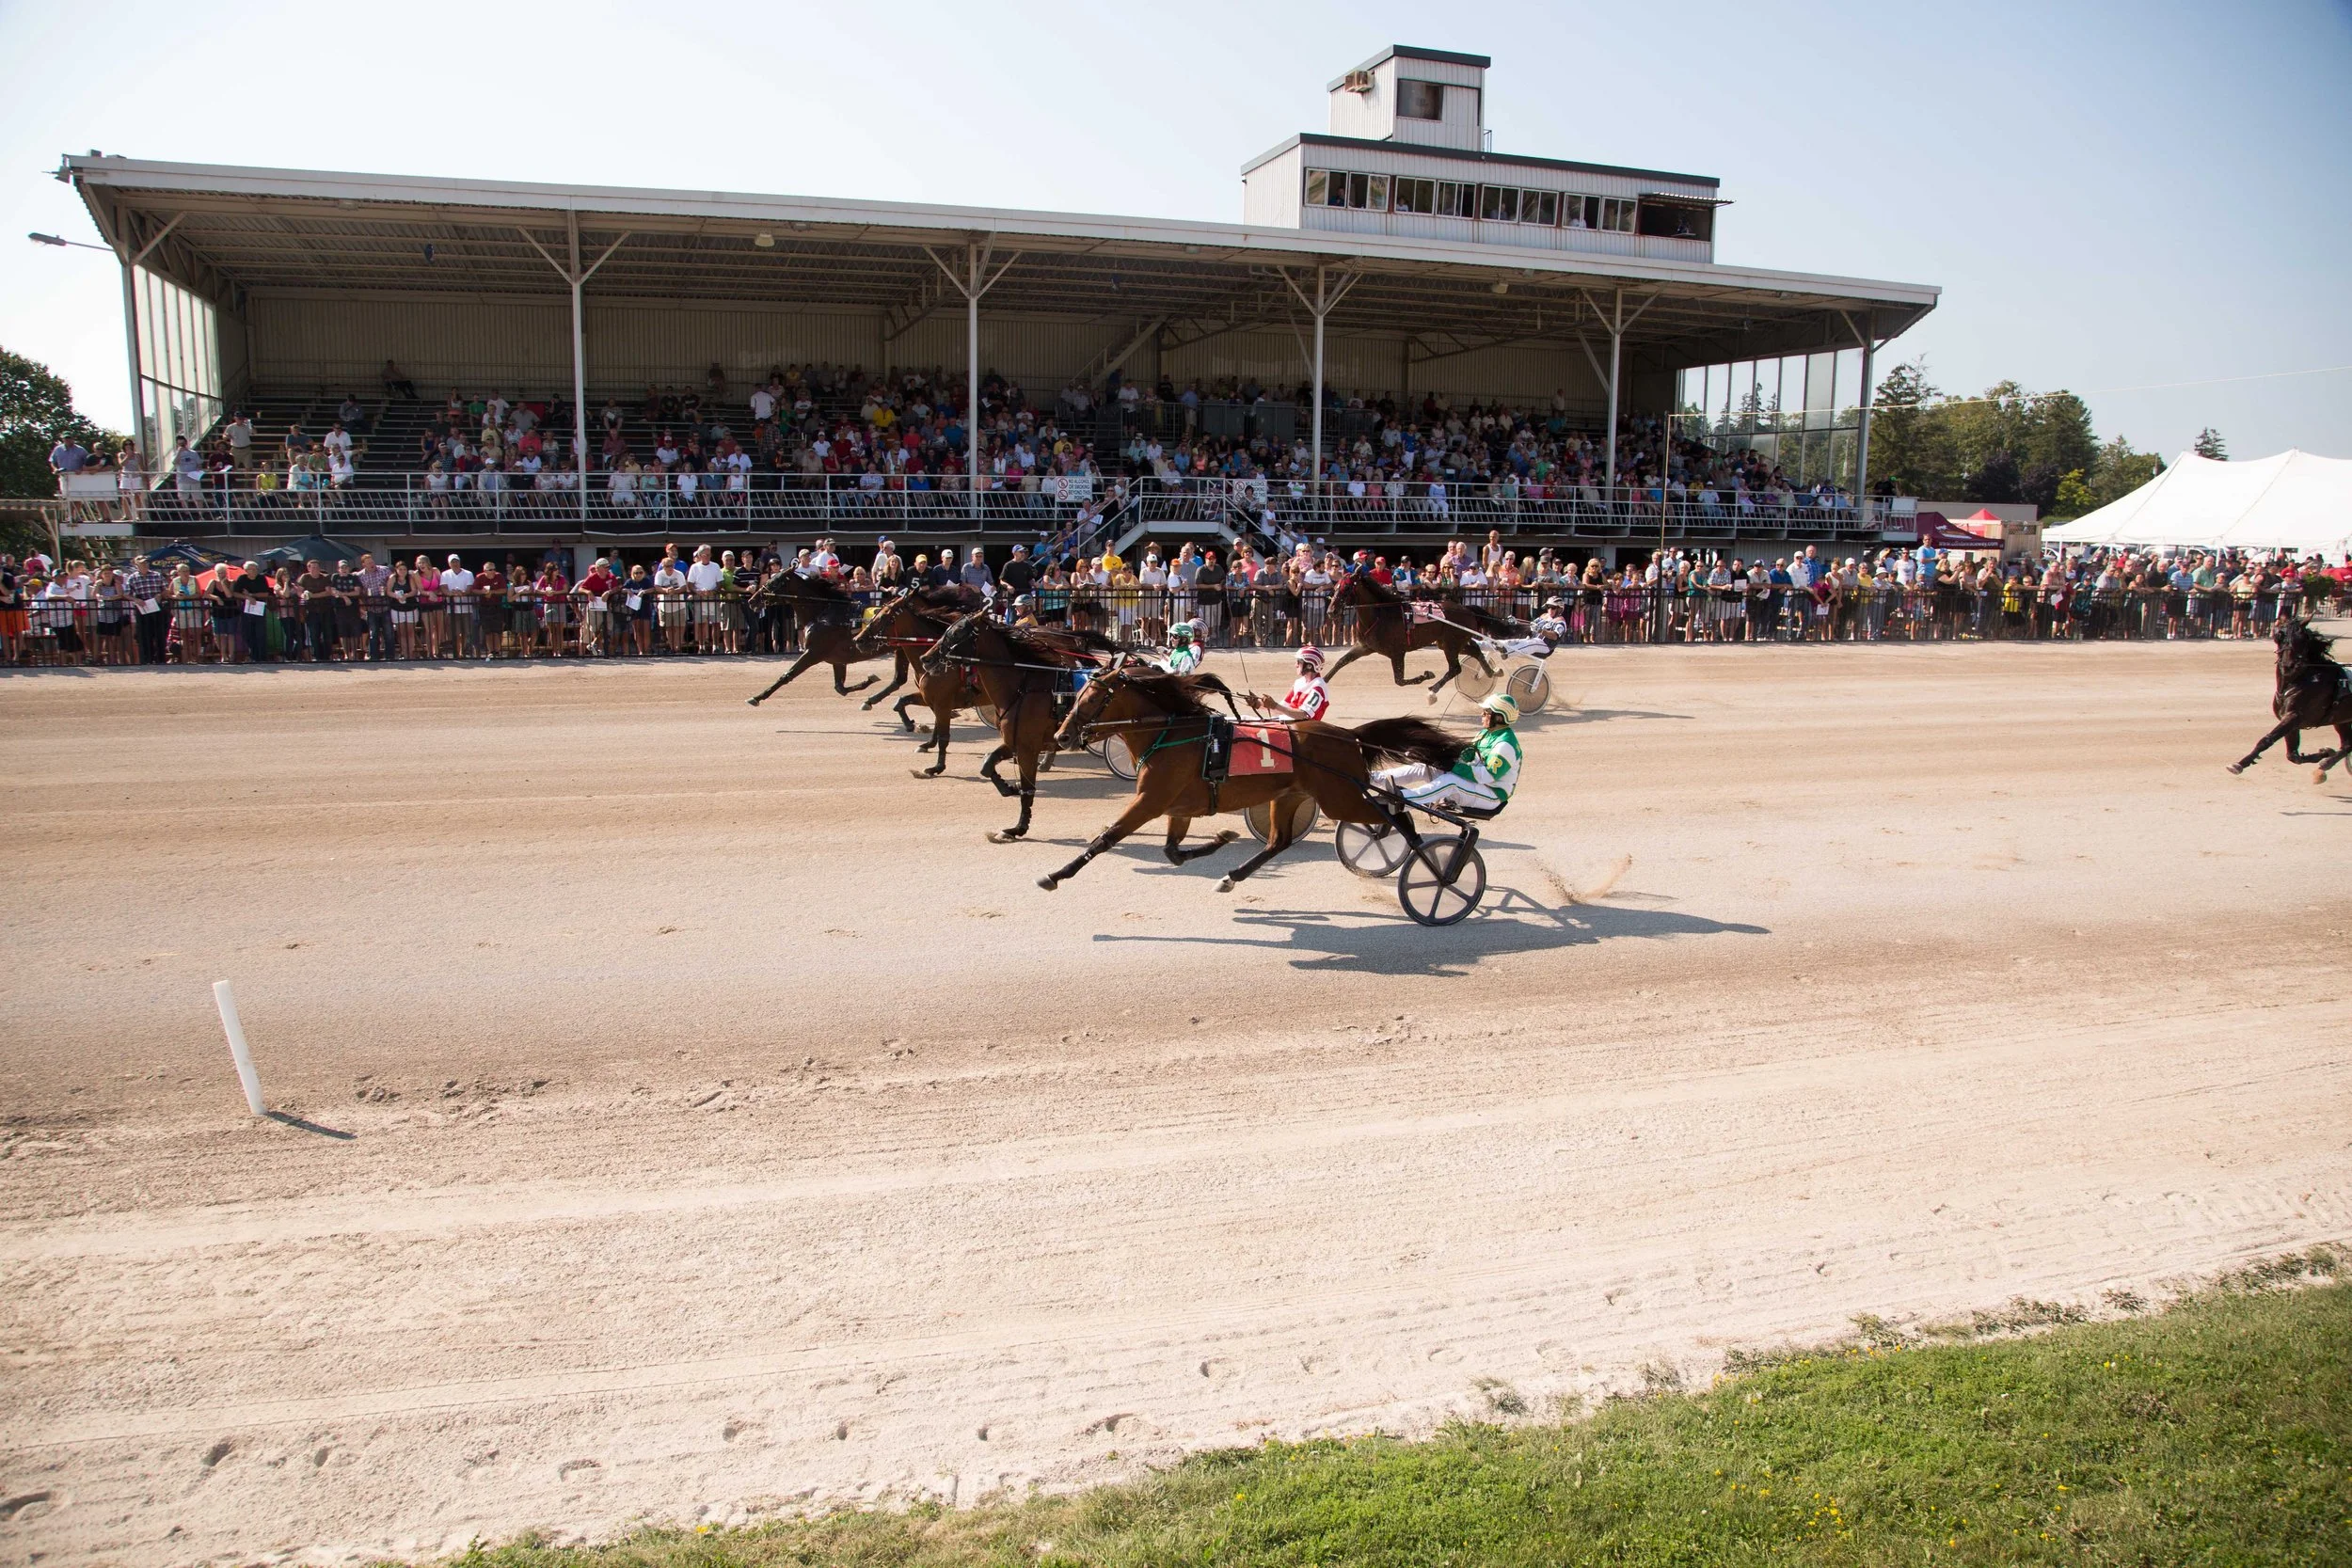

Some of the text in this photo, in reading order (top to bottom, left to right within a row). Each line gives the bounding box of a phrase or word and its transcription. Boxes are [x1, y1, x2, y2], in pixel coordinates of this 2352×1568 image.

[911, 577, 920, 589] 5
[898, 587, 909, 598] 4
[982, 596, 993, 612] 2
[1307, 691, 1320, 707] D
[1257, 728, 1274, 768] 1
[1486, 756, 1502, 774] R
